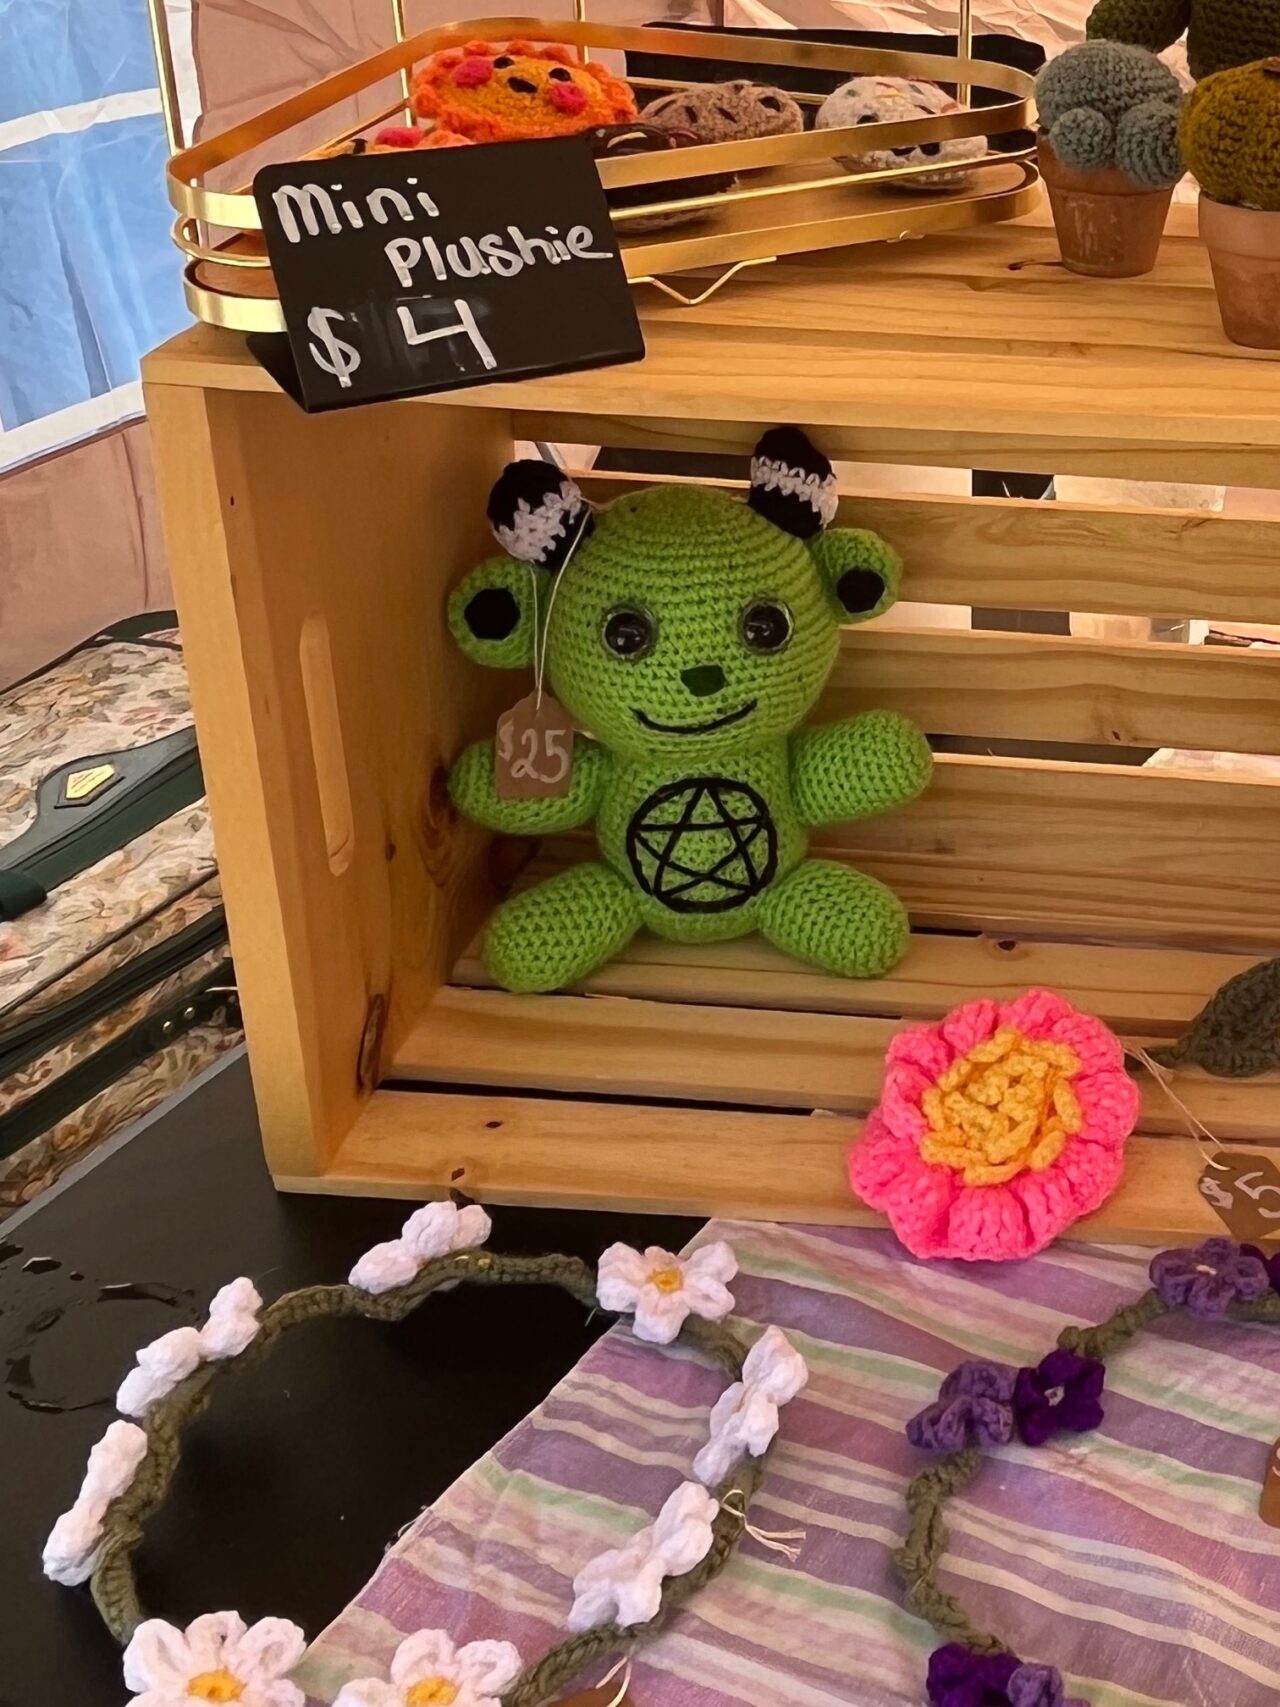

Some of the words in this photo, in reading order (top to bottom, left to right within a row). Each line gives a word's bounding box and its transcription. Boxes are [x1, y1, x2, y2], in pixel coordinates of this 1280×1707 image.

[271, 176, 440, 244] Mini
[384, 225, 614, 288] Plushie
[498, 719, 569, 784] $25
